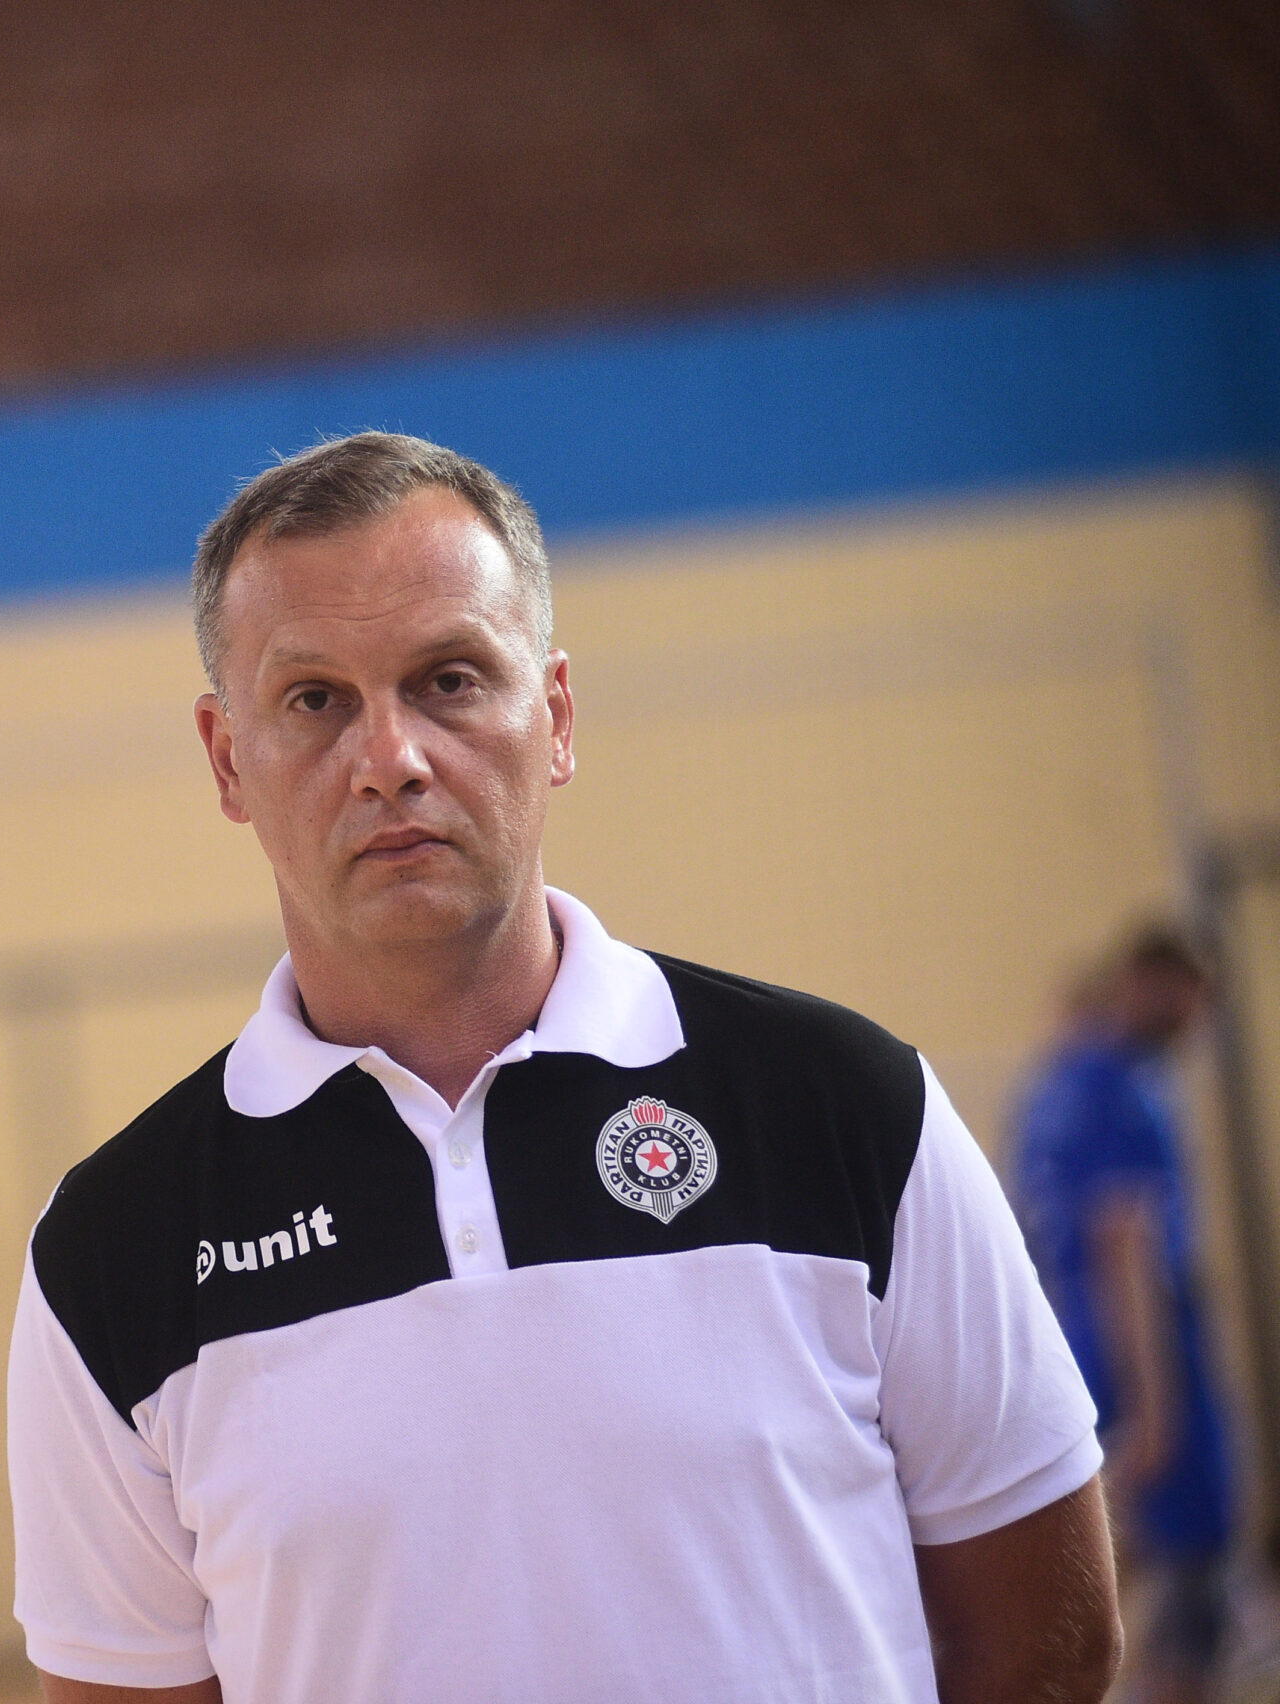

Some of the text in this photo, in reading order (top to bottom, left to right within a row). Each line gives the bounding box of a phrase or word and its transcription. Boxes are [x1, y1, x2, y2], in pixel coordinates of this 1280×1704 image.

[603, 1121, 644, 1202] PARTIZAN
[624, 1130, 688, 1164] RUKOMETNI
[638, 1173, 681, 1187] KLUB
[671, 1119, 709, 1200] ПАРТИЗАН
[221, 1204, 338, 1272] unit
